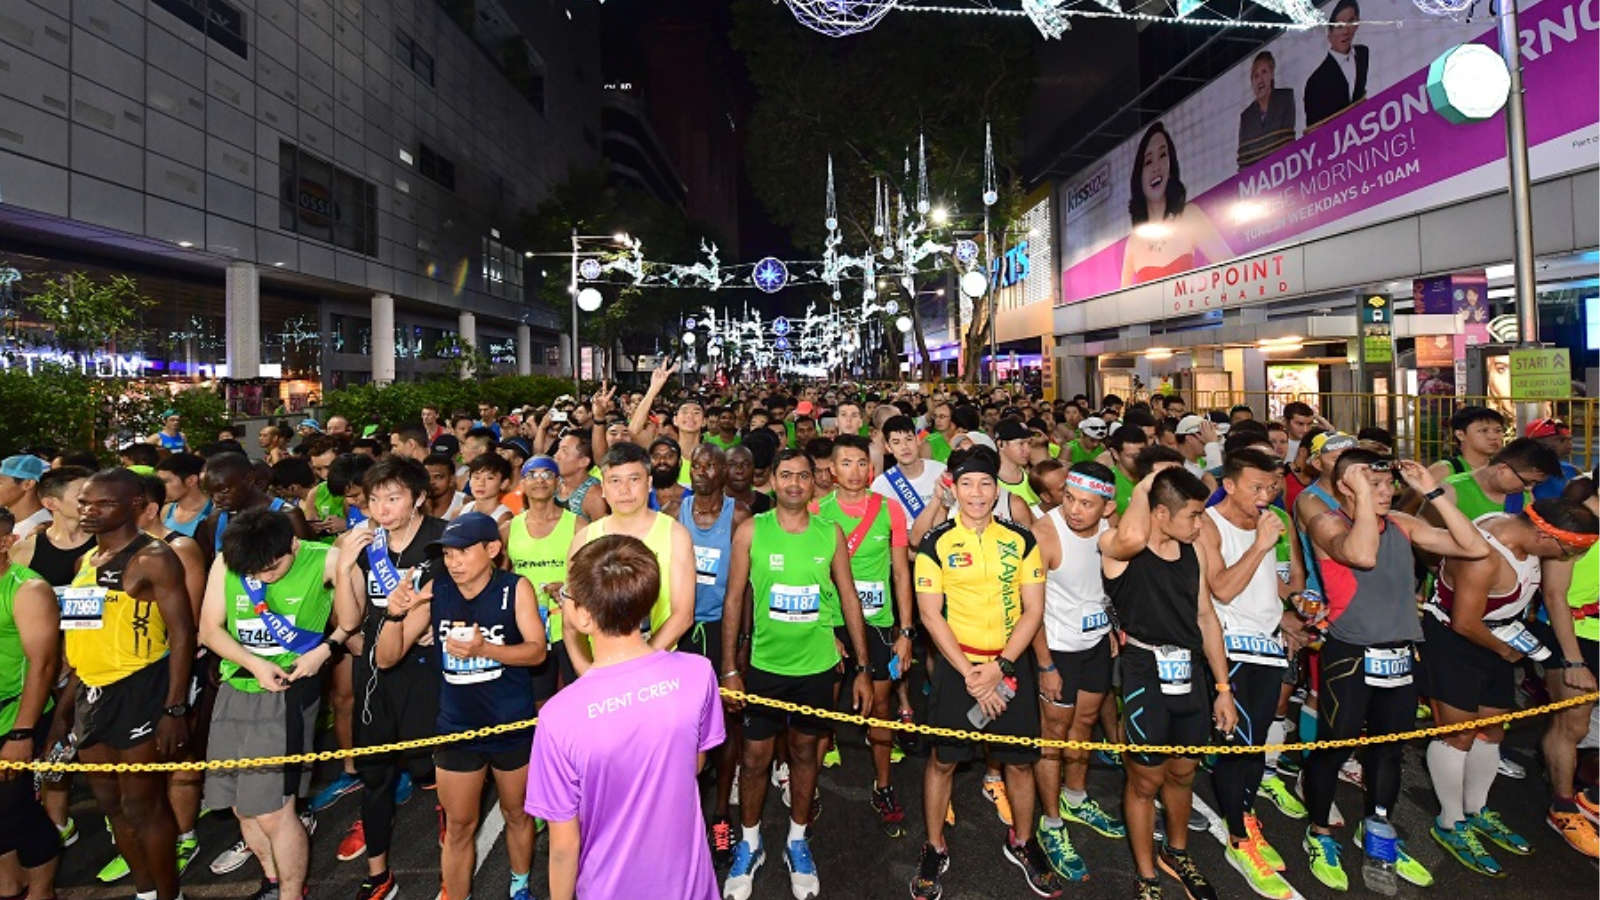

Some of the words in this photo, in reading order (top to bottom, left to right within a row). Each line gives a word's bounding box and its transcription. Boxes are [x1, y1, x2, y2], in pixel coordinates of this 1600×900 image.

[1237, 141, 1323, 200] MADDY,
[1327, 83, 1430, 161] JASON
[1299, 127, 1416, 200] MORNING!
[1361, 159, 1420, 195] 6-10AM
[1173, 281, 1288, 311] ORCHARD
[1516, 355, 1548, 370] START
[774, 593, 817, 611] B1187
[587, 691, 633, 719] EVENT
[637, 678, 681, 703] CREW
